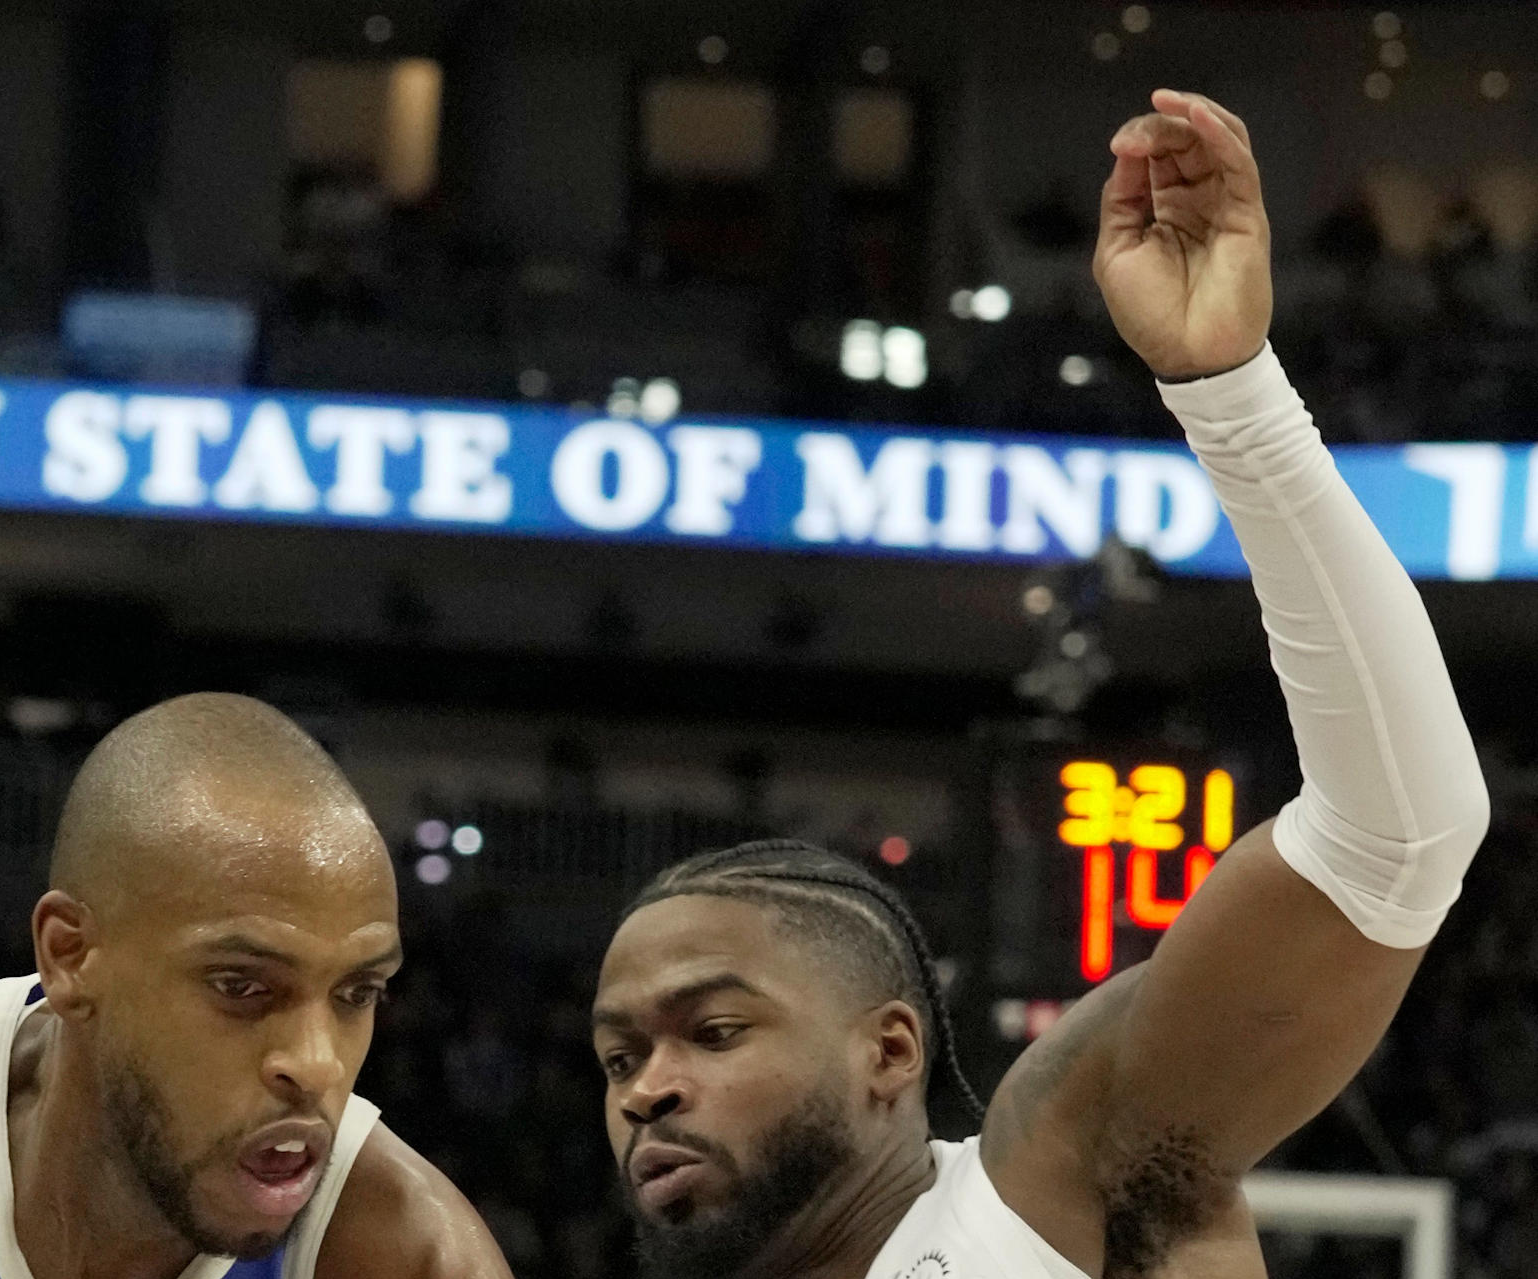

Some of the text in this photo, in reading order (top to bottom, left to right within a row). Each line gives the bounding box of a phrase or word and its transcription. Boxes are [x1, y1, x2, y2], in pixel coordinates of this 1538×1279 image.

[42, 390, 512, 524] STATE
[551, 418, 760, 537] OF
[793, 432, 1221, 563] MIND
[1058, 761, 1234, 852] 3:21
